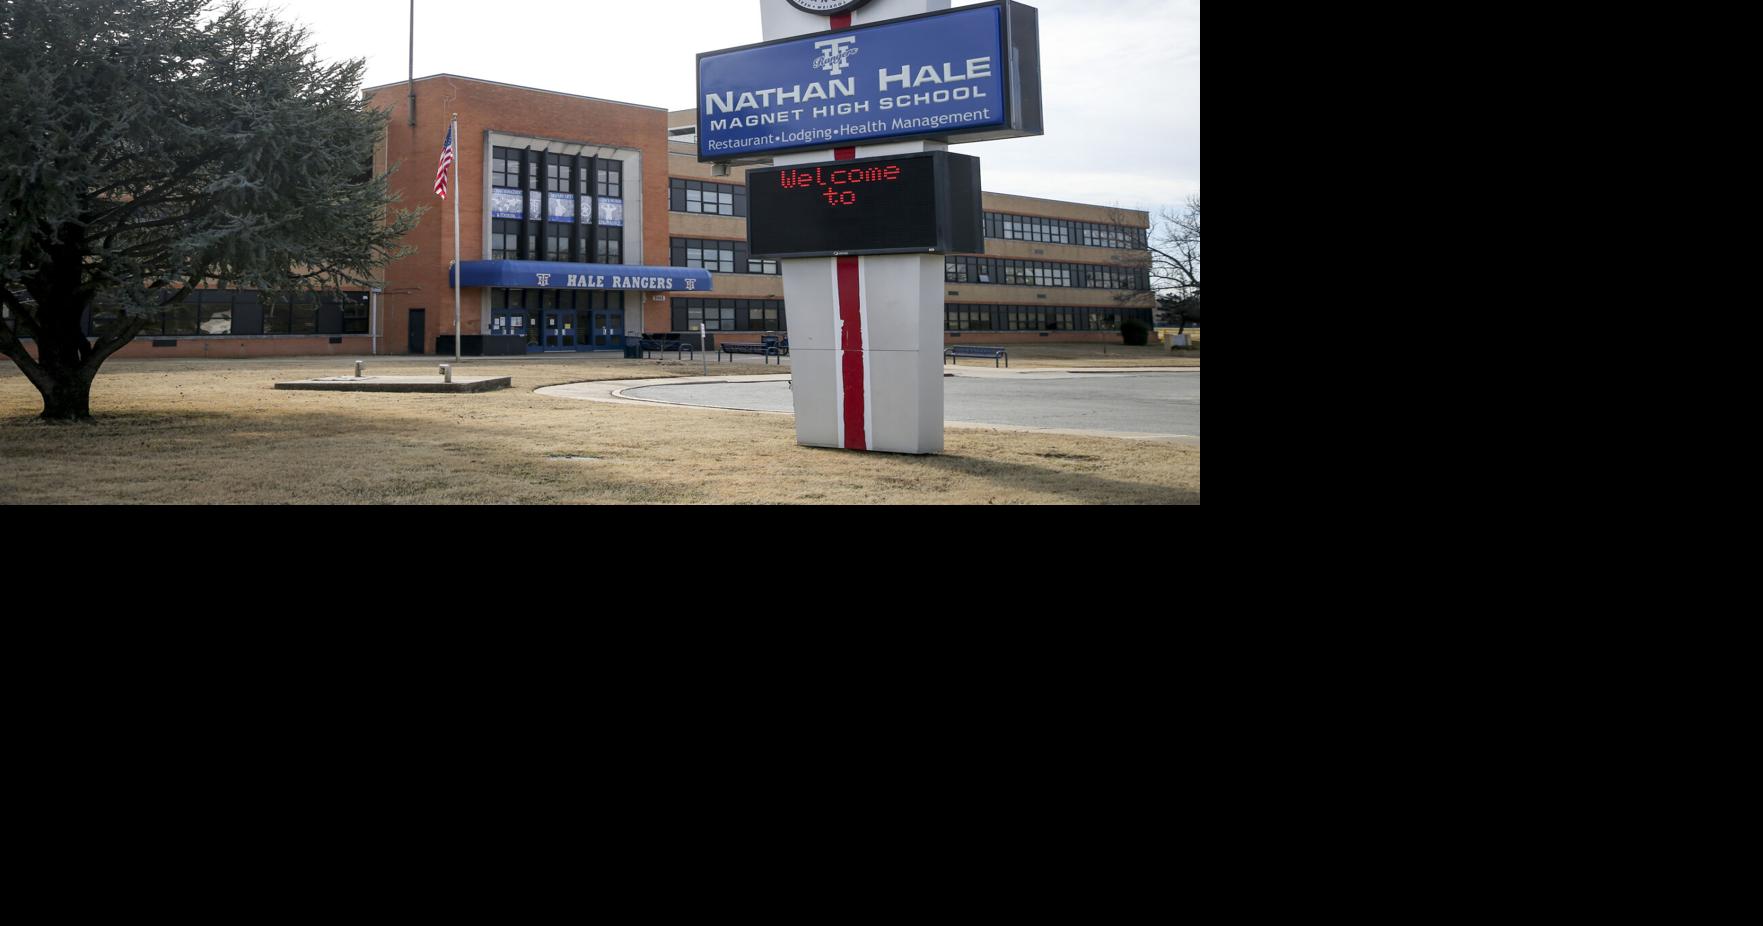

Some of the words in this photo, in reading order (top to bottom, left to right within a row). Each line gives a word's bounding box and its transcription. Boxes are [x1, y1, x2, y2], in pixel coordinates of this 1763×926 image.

[705, 77, 855, 115] NATHAN
[879, 56, 992, 92] HALE
[710, 109, 804, 131] MAGNET
[813, 100, 869, 118] HIGH
[879, 85, 987, 110] SCHOOL
[708, 134, 774, 150] Restaurant
[782, 127, 832, 142] Lodging
[840, 120, 887, 136] Health
[891, 107, 991, 129] Management
[781, 165, 900, 188] Welcome
[823, 187, 856, 206] to
[567, 274, 605, 288] HALE
[612, 275, 673, 289] RANGERS
